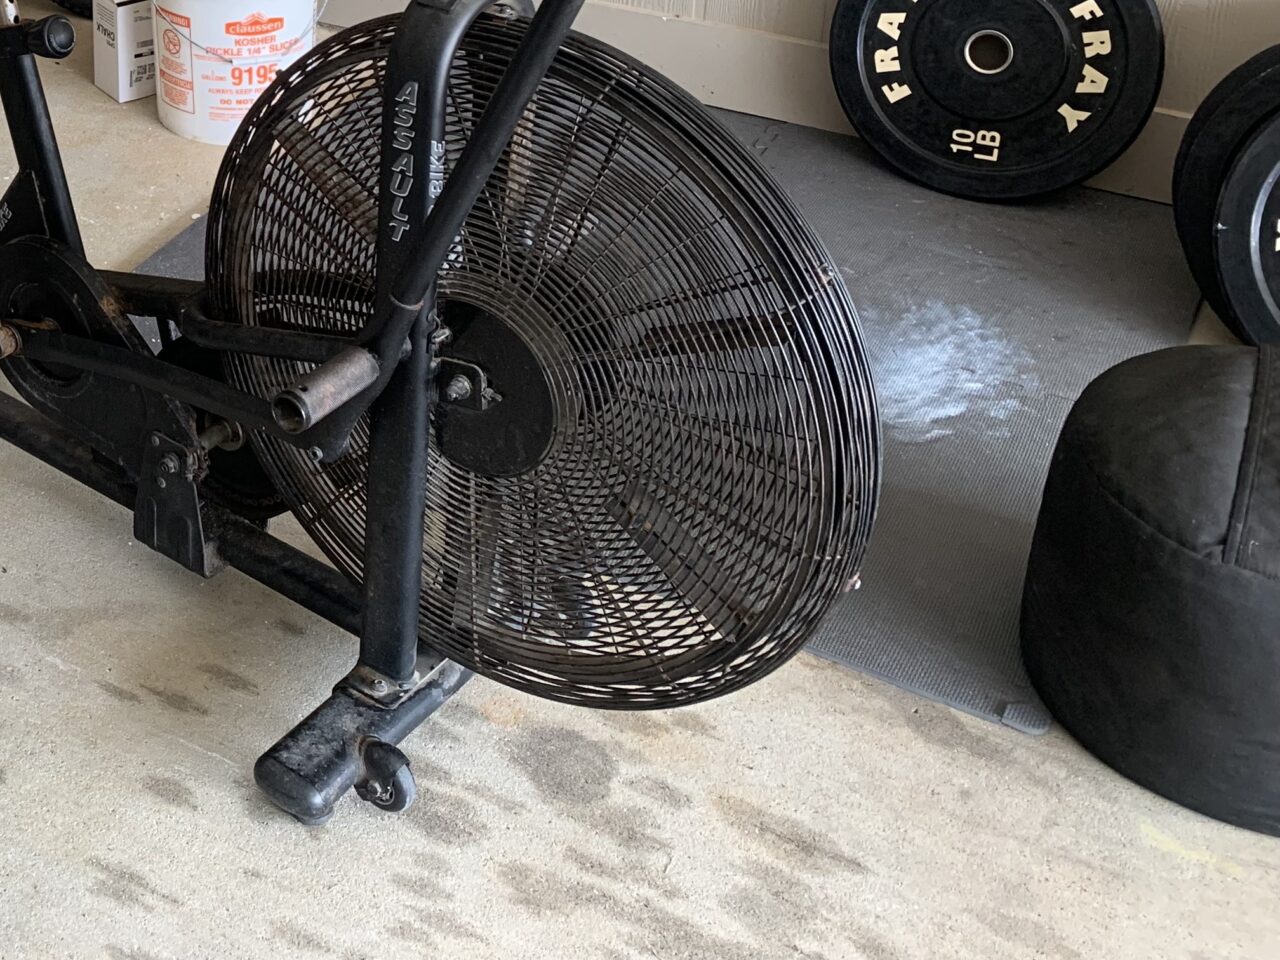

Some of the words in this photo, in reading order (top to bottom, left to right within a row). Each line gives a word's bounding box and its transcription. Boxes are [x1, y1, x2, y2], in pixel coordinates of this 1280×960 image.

[234, 34, 277, 47] KOSHER
[950, 128, 975, 154] 10
[973, 129, 1001, 162] LB
[389, 81, 419, 243] ASSAULT
[428, 140, 446, 199] BIKE
